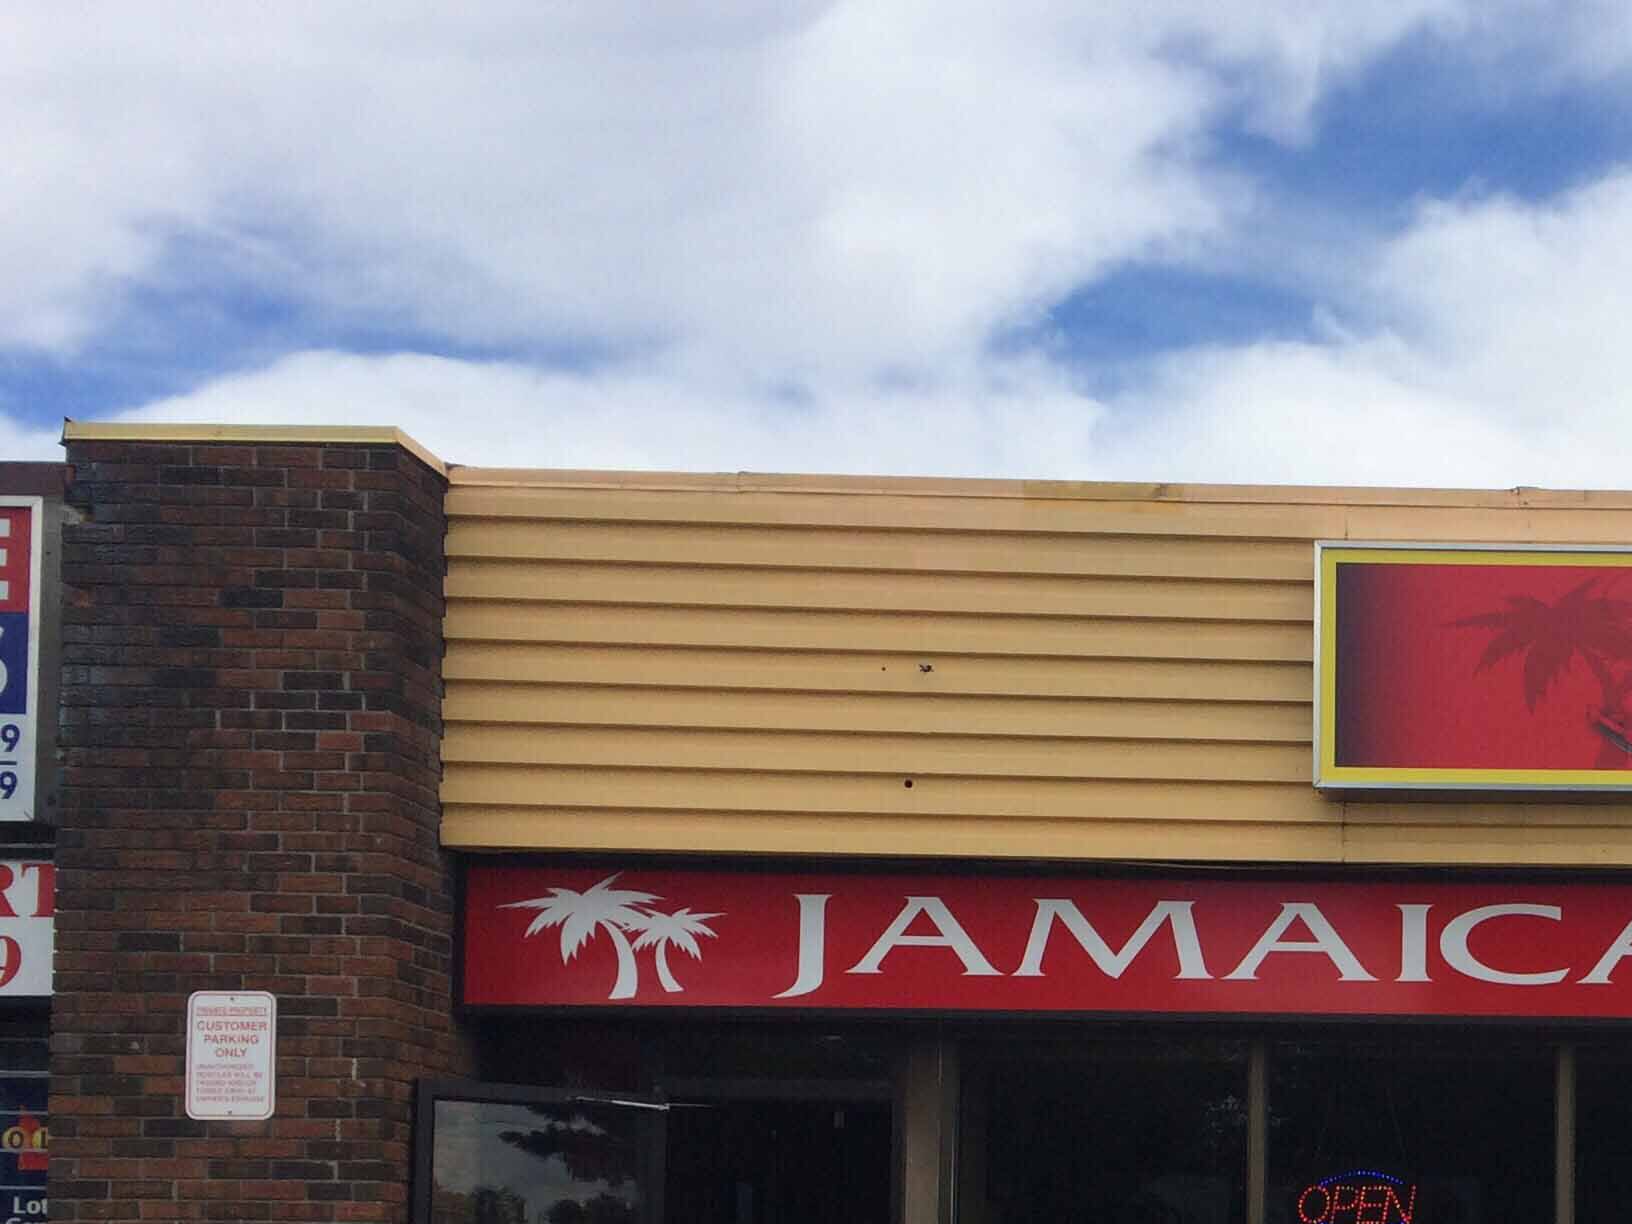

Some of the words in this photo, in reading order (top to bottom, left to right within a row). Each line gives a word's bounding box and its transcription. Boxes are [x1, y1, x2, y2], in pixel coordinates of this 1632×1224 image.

[197, 1020, 268, 1031] CUSTOMER
[204, 1034, 258, 1045] PARKING
[215, 1047, 247, 1057] ONLY
